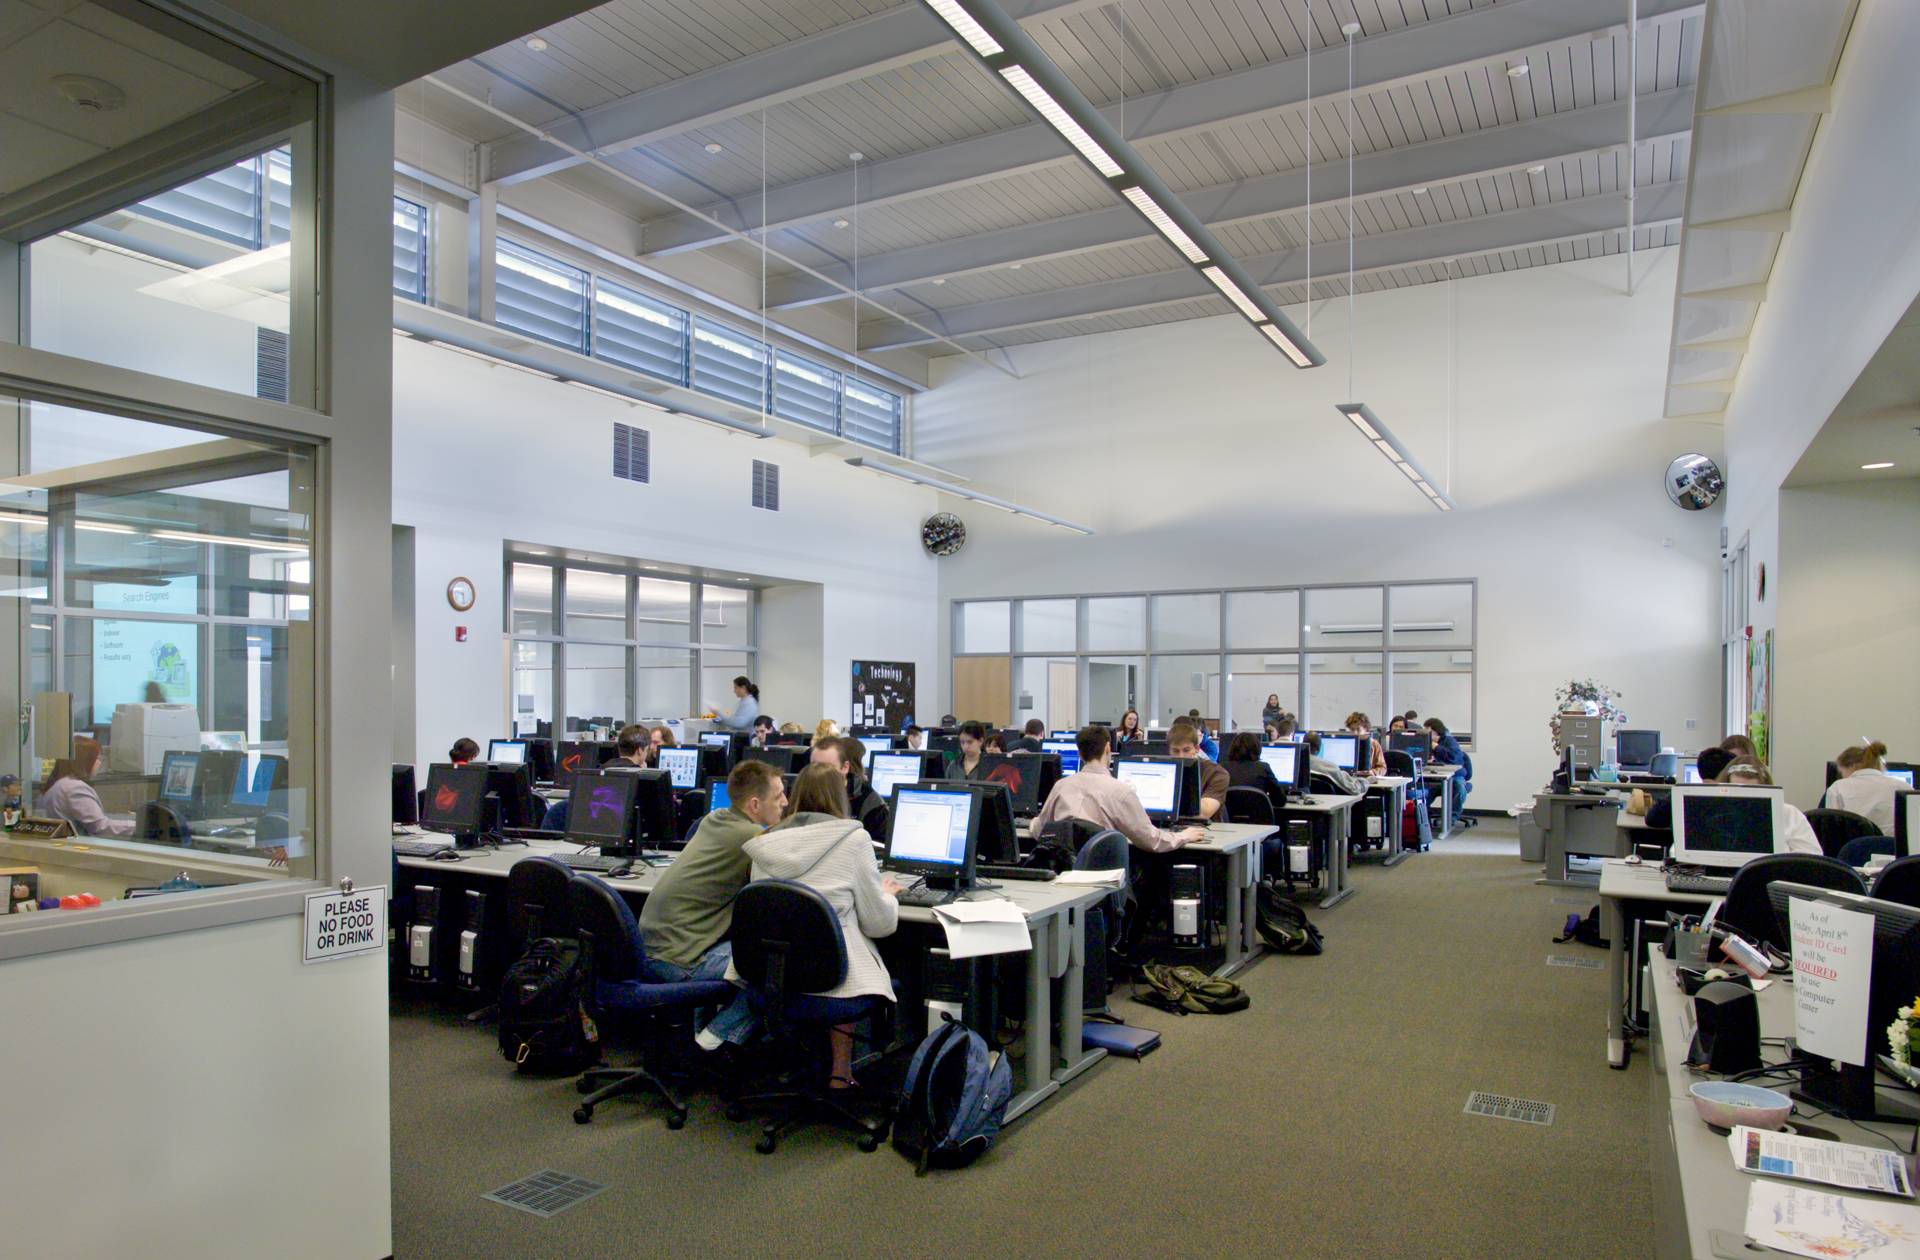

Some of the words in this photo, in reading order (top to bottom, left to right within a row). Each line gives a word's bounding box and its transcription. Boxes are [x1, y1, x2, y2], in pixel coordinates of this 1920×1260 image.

[122, 592, 143, 603] Search
[145, 591, 169, 603] Engines
[103, 641, 123, 649] Software
[103, 653, 120, 661] Results
[121, 654, 132, 662] vary
[870, 665, 902, 682] Technology
[325, 898, 369, 917] PLEASE
[319, 918, 337, 933] NO
[341, 913, 374, 930] FOOD
[1809, 912, 1819, 921] As
[1820, 915, 1830, 924] of
[317, 934, 335, 949] OR
[338, 928, 374, 946] DRINK
[1815, 927, 1835, 938] April
[1793, 932, 1813, 946] Student
[1814, 939, 1825, 949] ID
[1826, 942, 1847, 955] Card
[1802, 950, 1815, 960] will
[1816, 952, 1826, 963] be
[1801, 975, 1807, 983] to
[1808, 978, 1821, 988] use
[1799, 986, 1836, 1005] Computer
[1798, 999, 1819, 1013] Center
